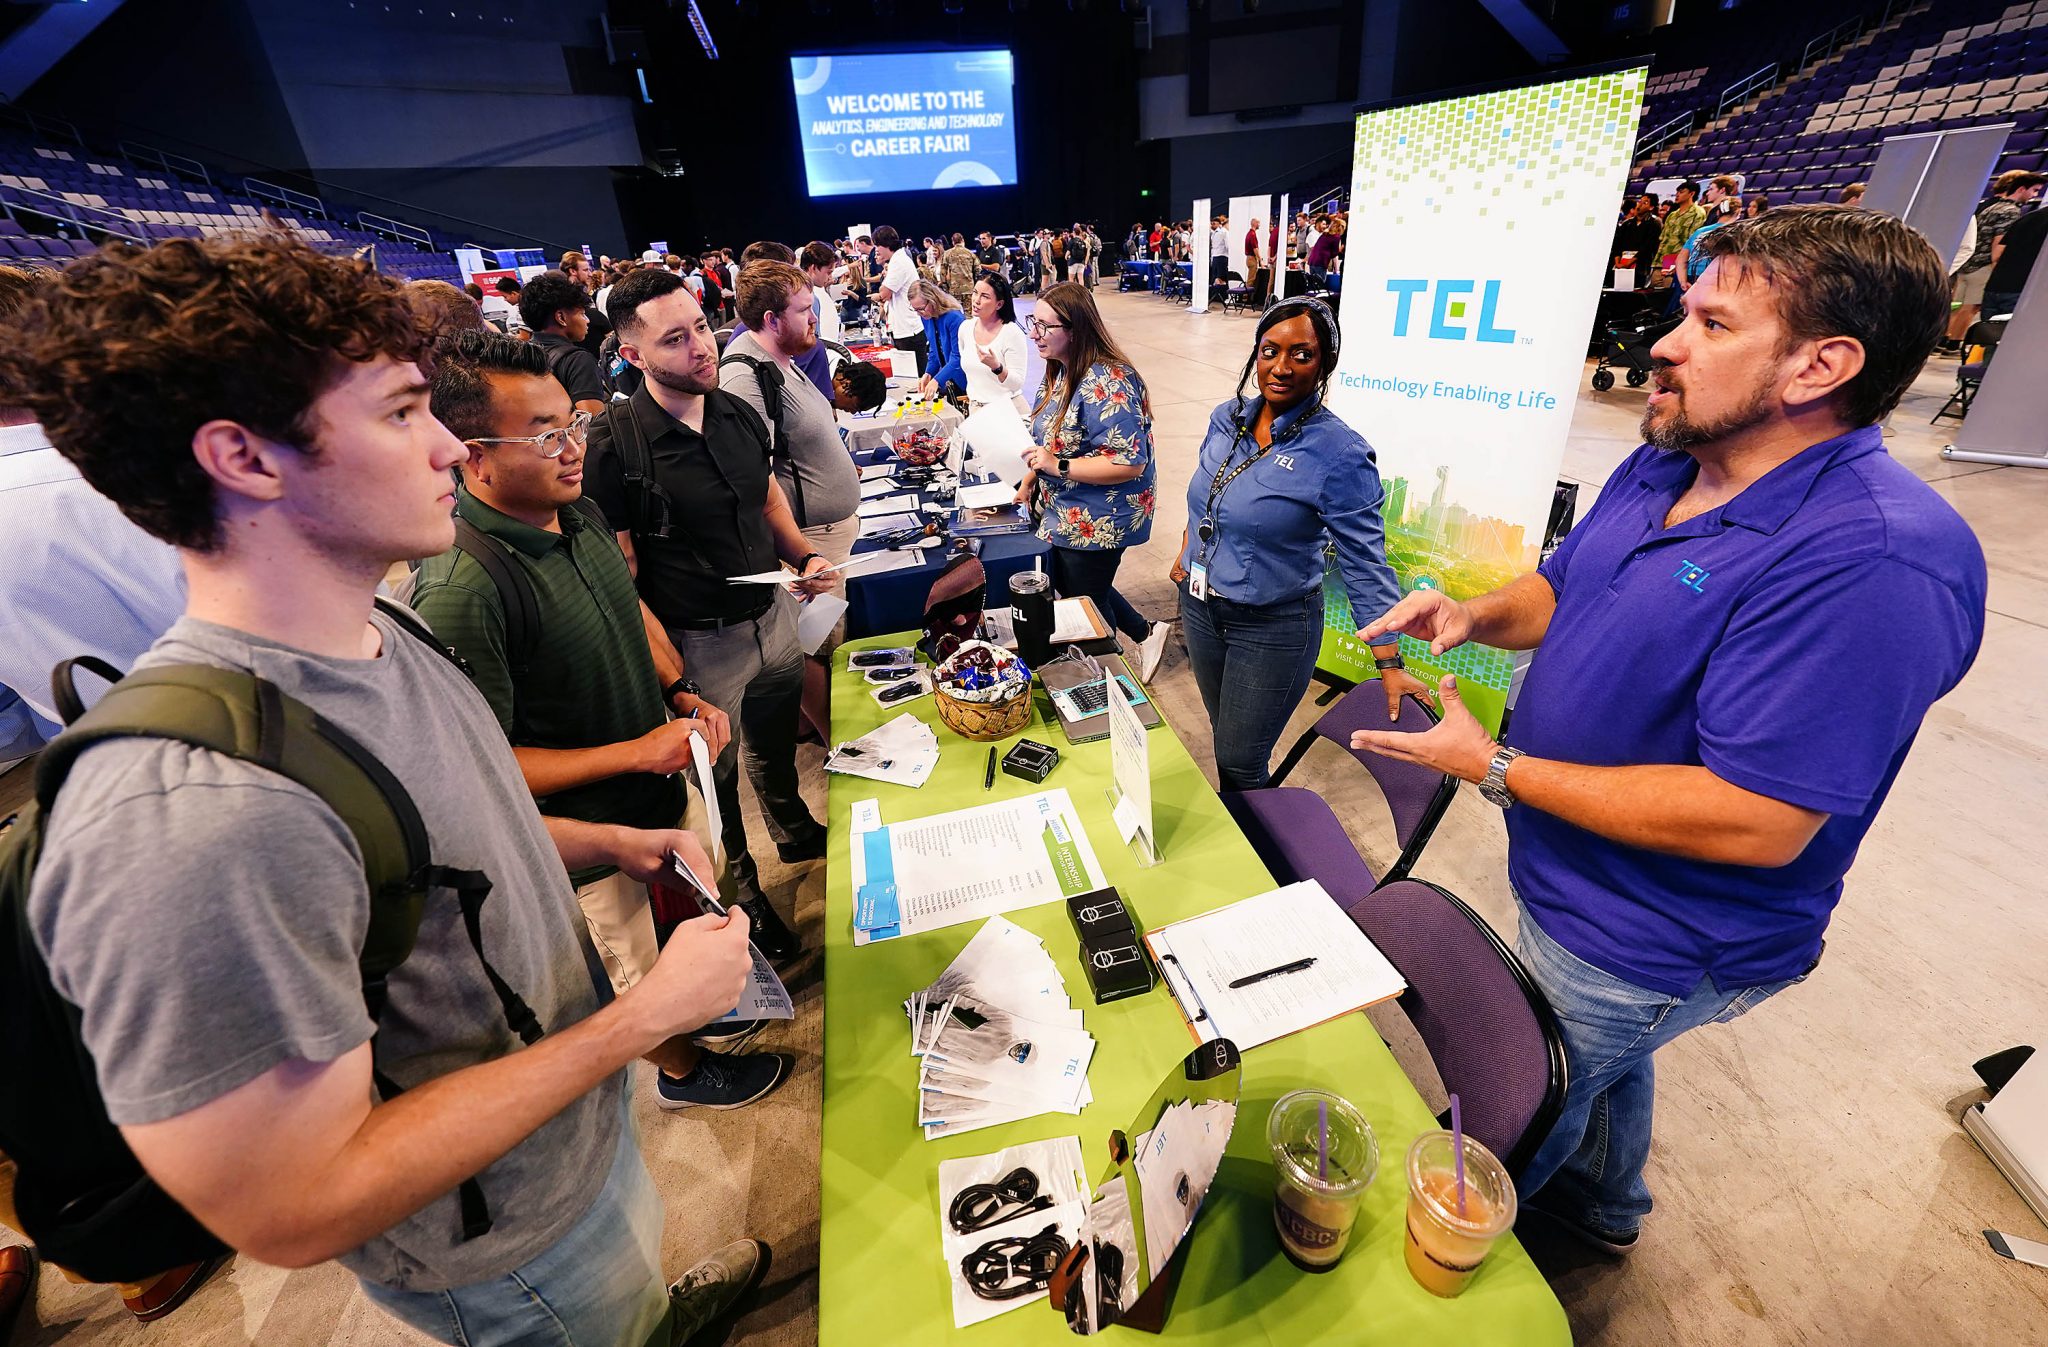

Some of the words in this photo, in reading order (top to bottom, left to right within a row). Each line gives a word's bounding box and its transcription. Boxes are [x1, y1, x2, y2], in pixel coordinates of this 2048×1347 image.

[827, 93, 922, 114] WELCOME
[923, 92, 947, 110] TO
[949, 90, 985, 109] THE
[811, 117, 865, 136] ANALYTICS,
[866, 115, 927, 134] ENGINEERING
[927, 114, 948, 130] AND
[948, 113, 1004, 129] TECHNOLOGY
[851, 137, 921, 158] CAREER
[924, 134, 971, 154] FAIR!
[1386, 279, 1516, 344] TEL
[1339, 372, 1429, 399] Technology
[1433, 381, 1512, 410] Enabling
[1517, 390, 1556, 410] Life
[1274, 453, 1296, 471] TEL
[1671, 559, 1711, 593] TEL
[1335, 651, 1353, 664] visit
[1354, 659, 1365, 669] us
[1036, 797, 1051, 815] TEL
[1050, 819, 1067, 843] HIRING
[1055, 850, 1075, 889] OPPORTUNITIES
[1060, 846, 1084, 889] INTERNSHIP
[1063, 1057, 1079, 1078] TEL
[1007, 1189, 1018, 1198] TEL
[1035, 1279, 1048, 1290] TEL
